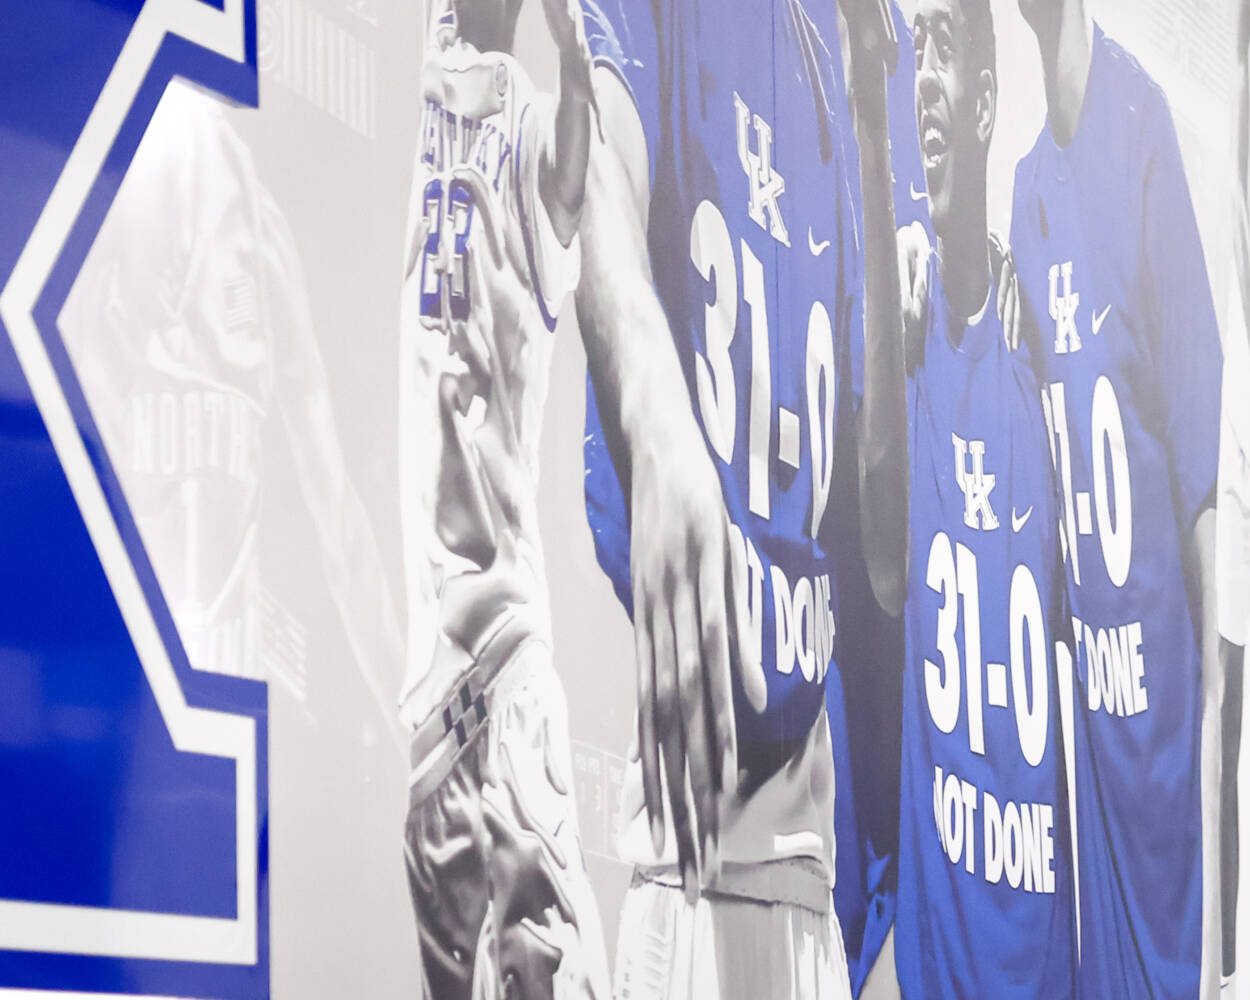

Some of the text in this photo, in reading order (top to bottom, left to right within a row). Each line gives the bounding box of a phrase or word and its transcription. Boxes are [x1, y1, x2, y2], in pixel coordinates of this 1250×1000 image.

[690, 199, 835, 541] 31-0
[924, 532, 1048, 767] 31-0
[1084, 620, 1149, 718] DONE
[983, 791, 1055, 893] DONE
